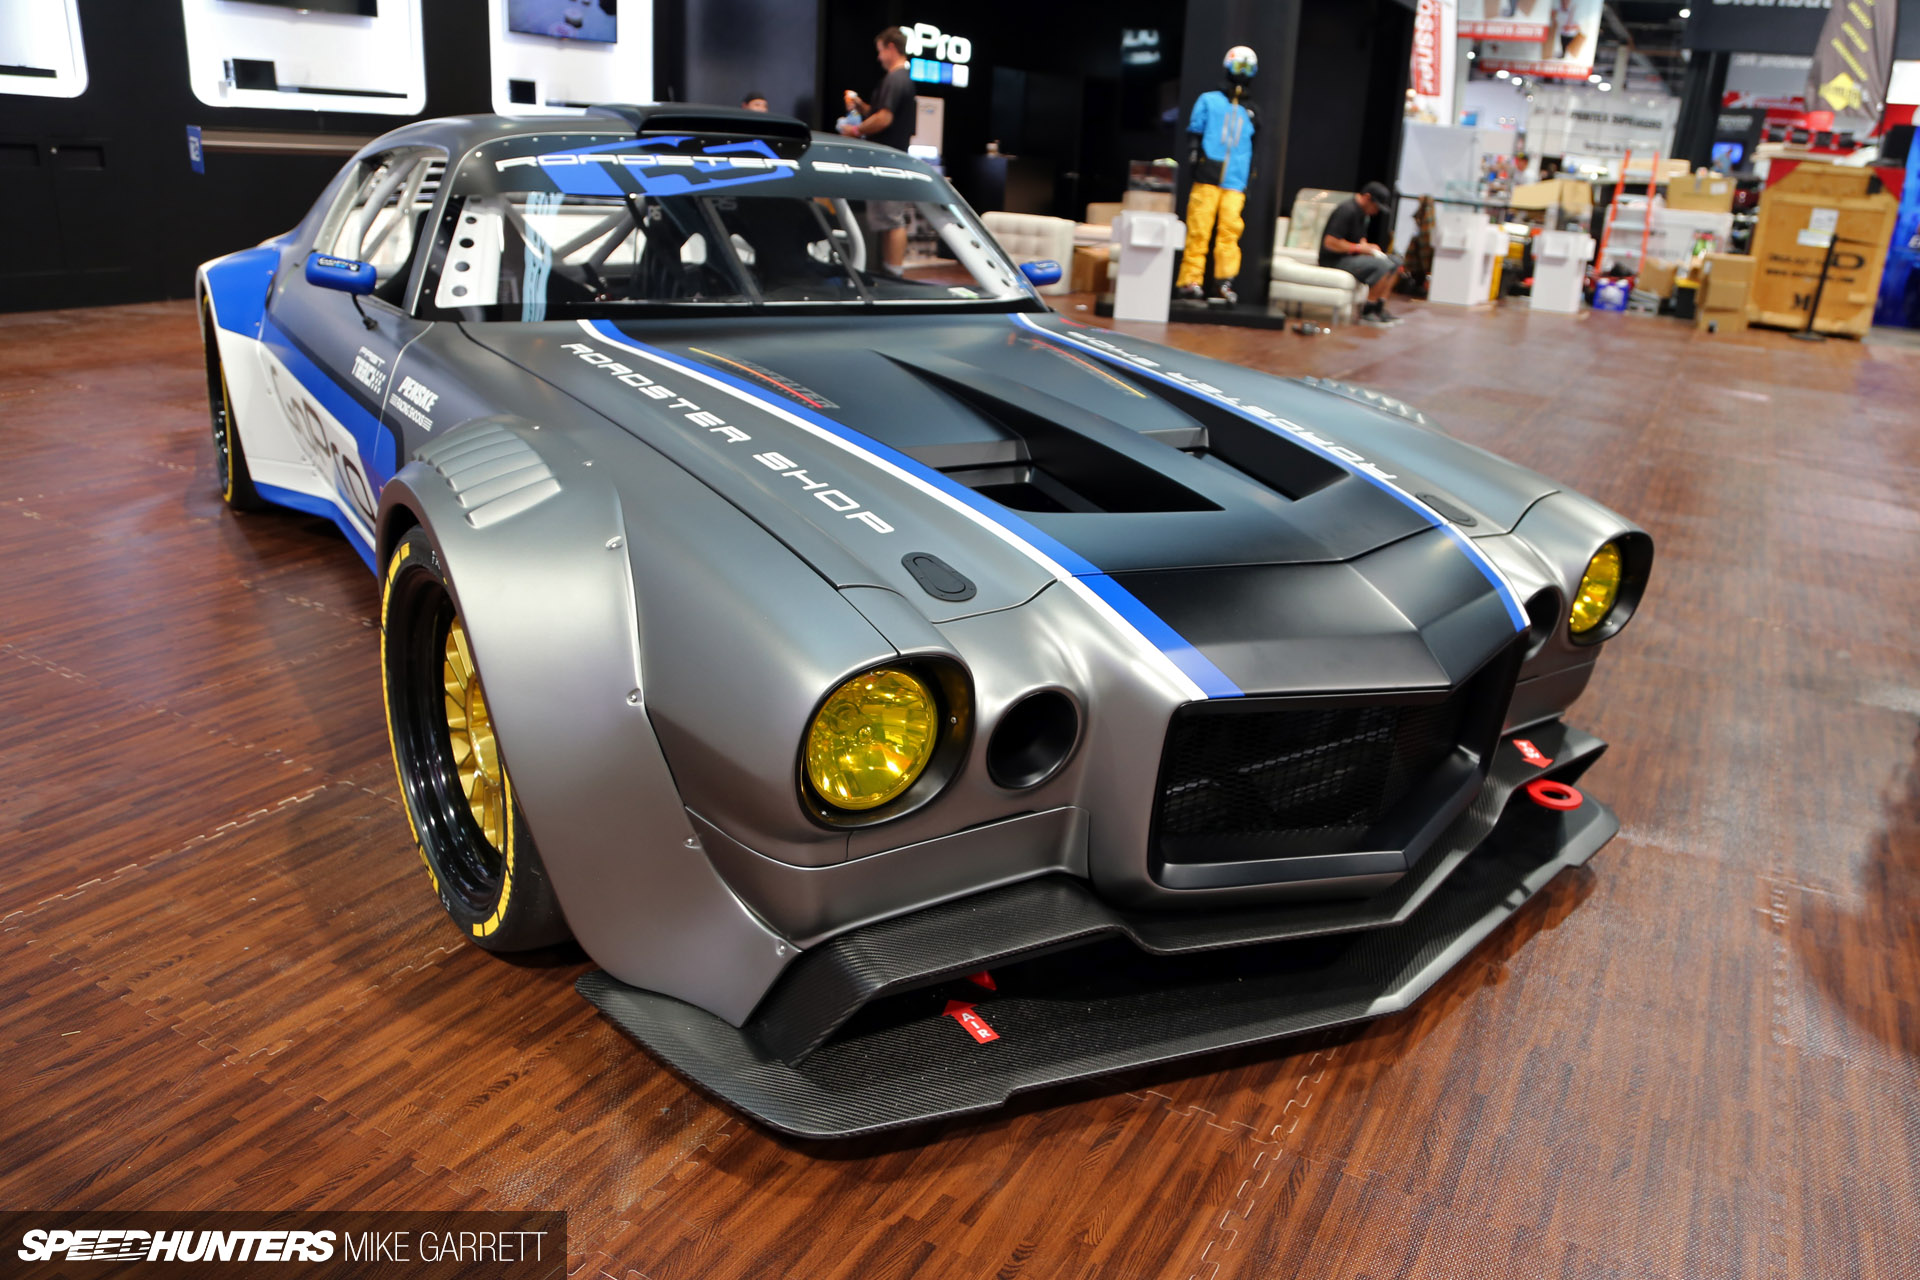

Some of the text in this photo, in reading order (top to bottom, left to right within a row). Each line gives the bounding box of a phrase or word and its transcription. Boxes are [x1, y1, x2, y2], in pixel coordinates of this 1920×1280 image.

[899, 22, 972, 64] Pro
[496, 154, 933, 183] ROADSTER SHOP
[397, 376, 439, 412] PENSKE
[560, 343, 752, 443] ROADSTER
[753, 451, 895, 534] SHOP
